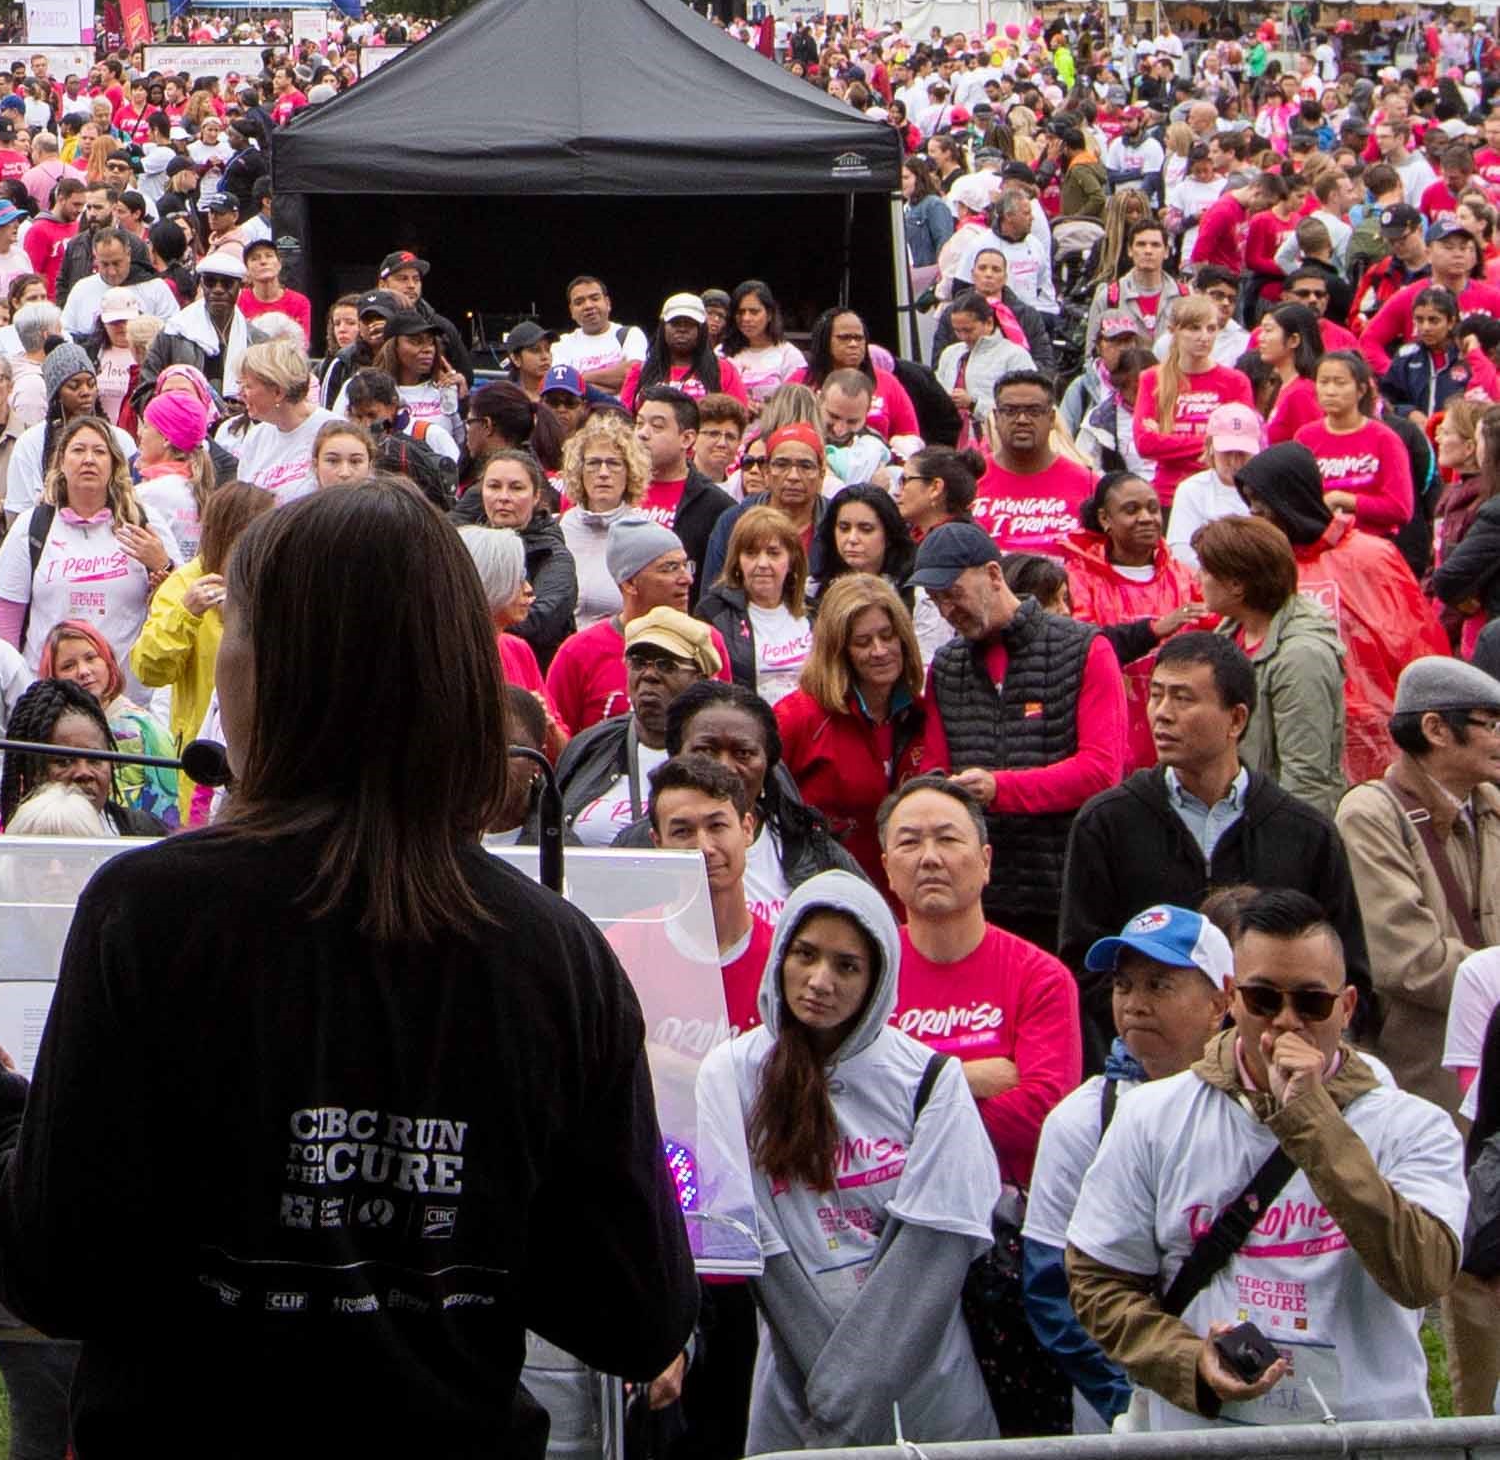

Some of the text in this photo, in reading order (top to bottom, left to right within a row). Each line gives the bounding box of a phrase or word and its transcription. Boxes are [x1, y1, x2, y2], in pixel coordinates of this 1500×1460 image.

[553, 366, 569, 382] T
[290, 1107, 468, 1153] CIBC RUN
[325, 1142, 464, 1195] CURE
[271, 1295, 306, 1309] CLIF
[1251, 1290, 1307, 1313] CURE
